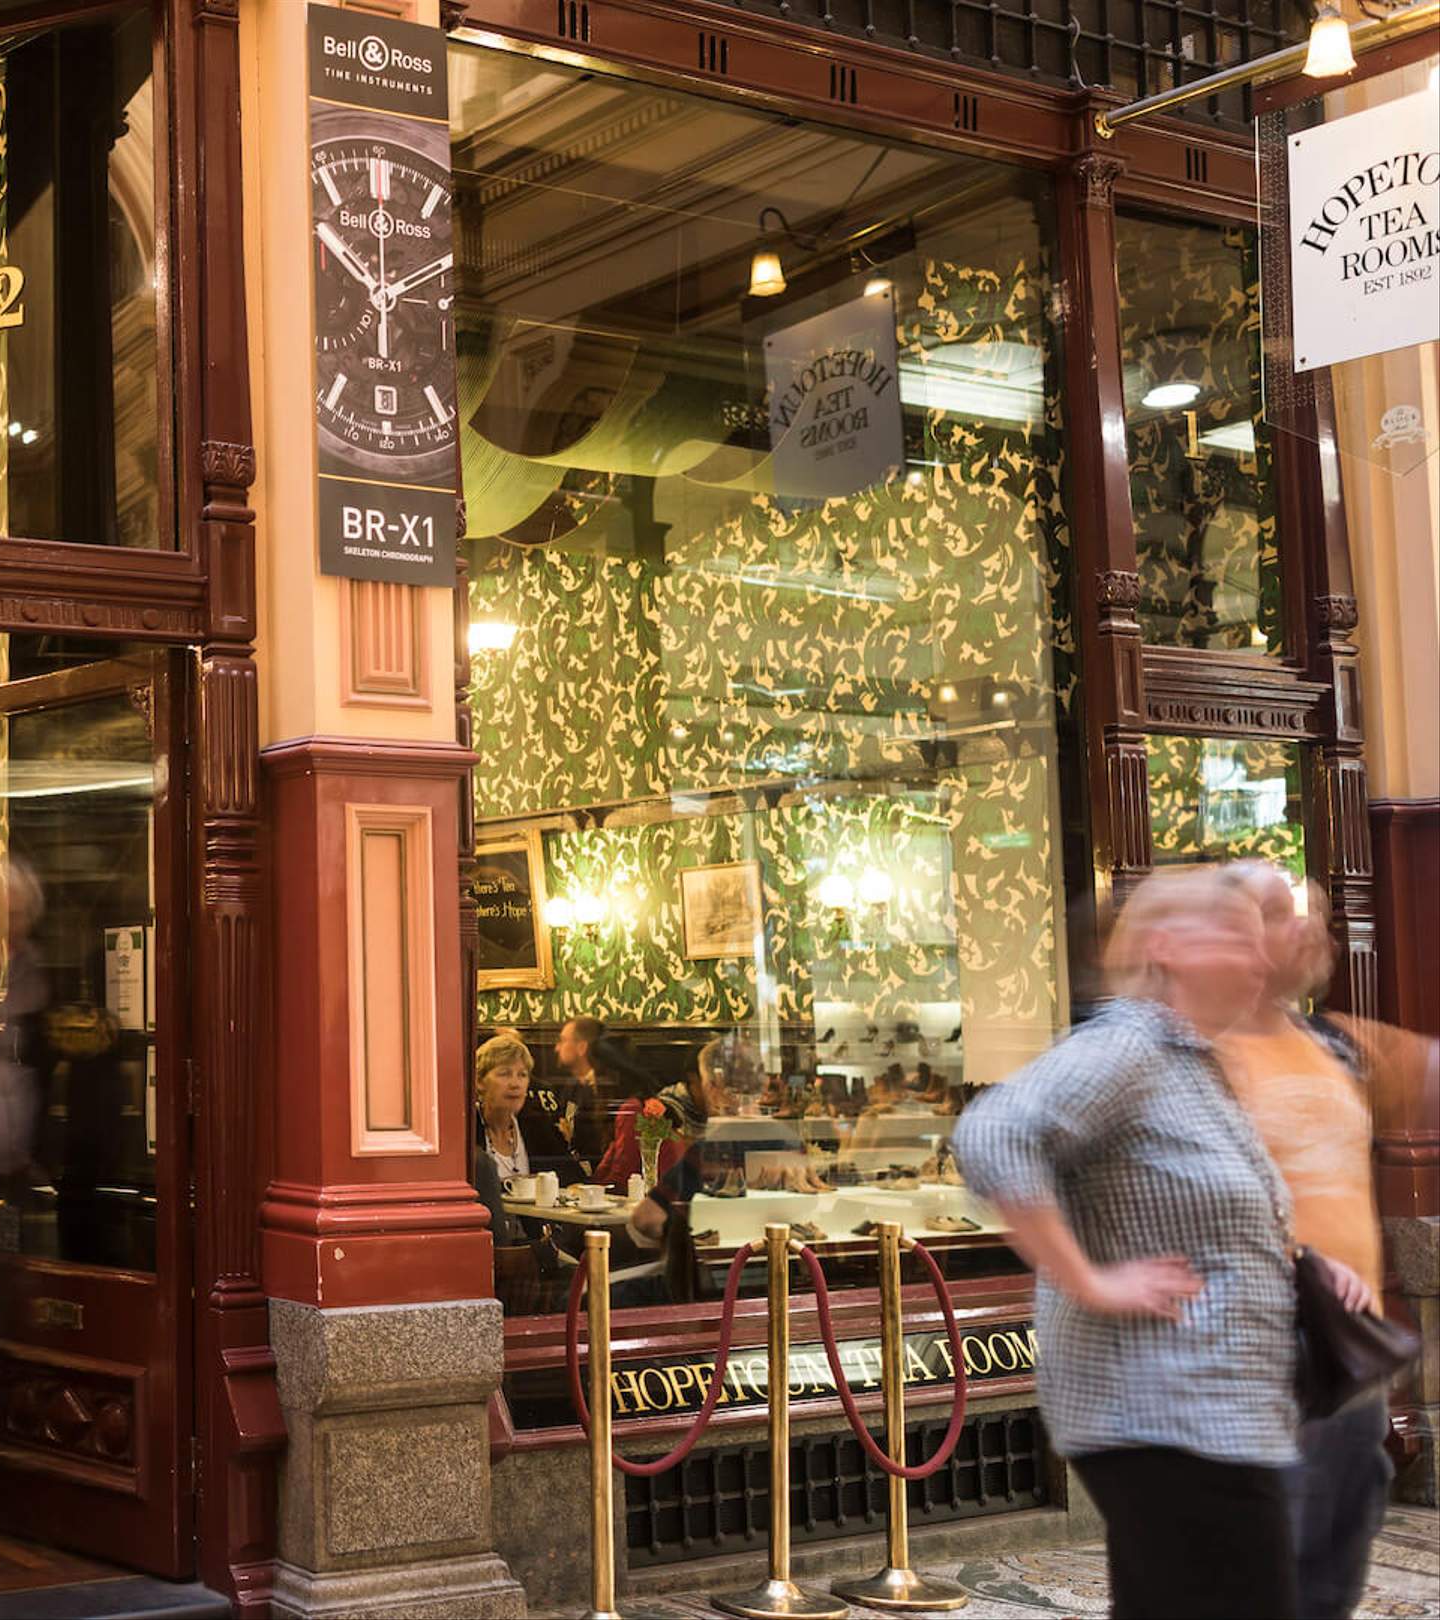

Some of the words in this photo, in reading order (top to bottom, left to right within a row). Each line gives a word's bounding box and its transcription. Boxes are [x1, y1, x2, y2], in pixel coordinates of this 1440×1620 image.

[323, 36, 356, 59] Bell
[362, 39, 386, 67] &
[391, 49, 433, 74] Ross
[324, 67, 351, 80] TIME
[356, 73, 433, 95] INSTRUMENTS
[1300, 152, 1440, 256] HOPETO
[339, 210, 367, 229] Bell
[395, 219, 431, 239] Ross
[1359, 202, 1428, 241] TEA
[1363, 274, 1394, 295] EST
[1399, 265, 1432, 286] 1892
[368, 358, 402, 372] BR-X1
[342, 506, 434, 548] BR-X1
[343, 546, 380, 558] SKELETON
[845, 1343, 937, 1388] TA
